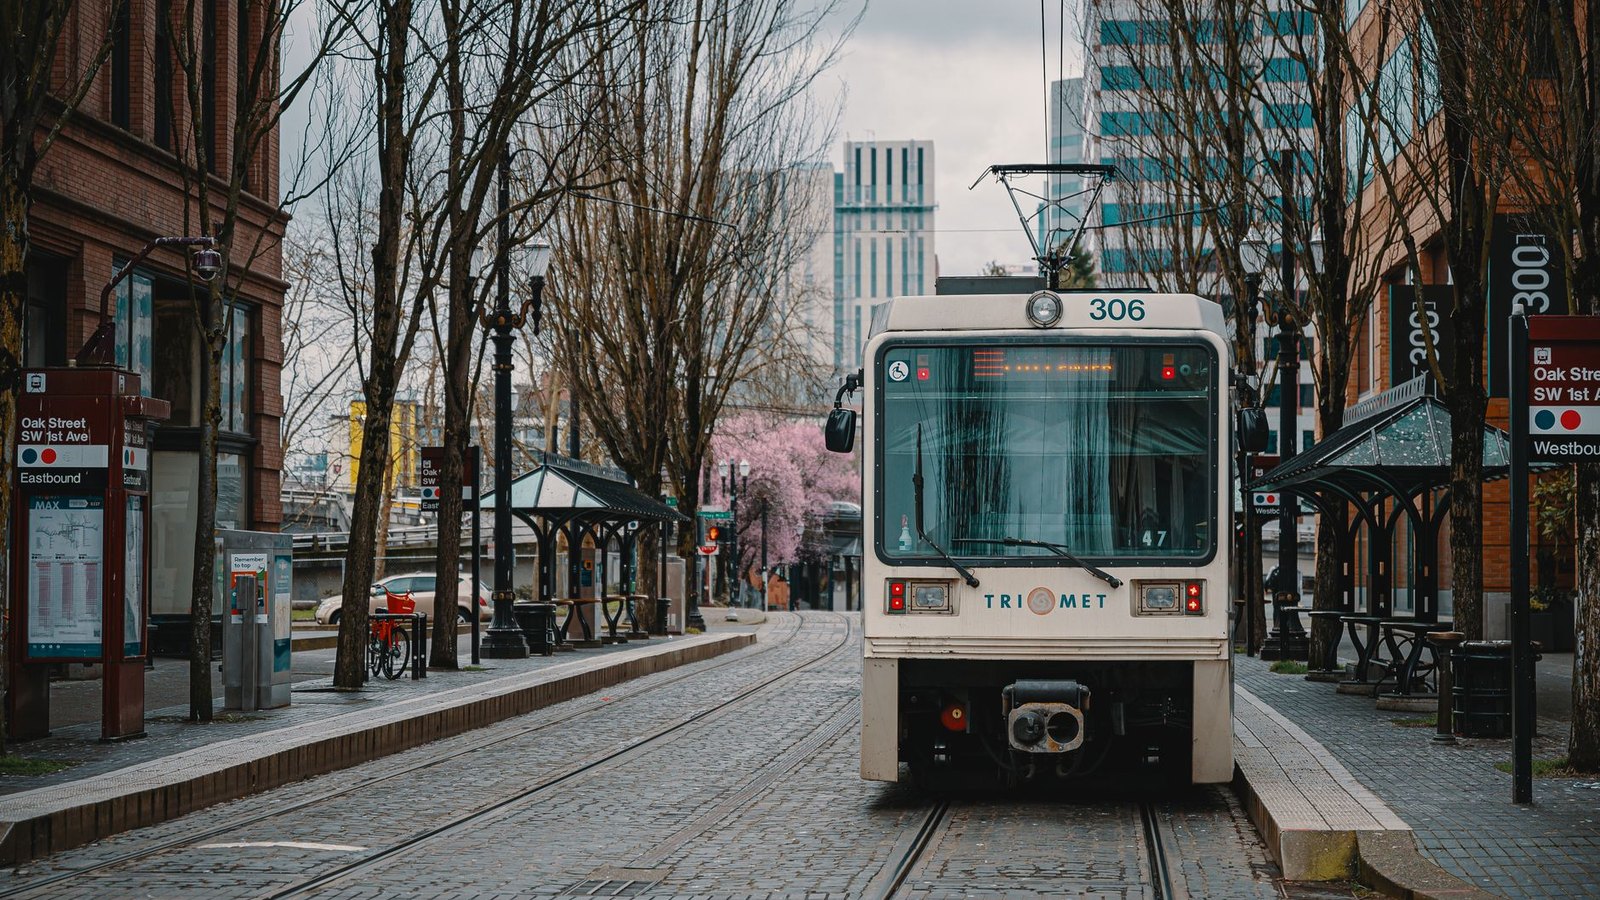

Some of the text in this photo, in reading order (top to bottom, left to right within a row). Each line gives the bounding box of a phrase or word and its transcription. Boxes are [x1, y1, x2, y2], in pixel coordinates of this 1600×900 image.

[1090, 298, 1146, 321] 306
[1533, 367, 1567, 381] Oak
[1533, 387, 1562, 401] SW
[1567, 387, 1590, 401] 1st
[21, 417, 86, 429] Oak Street
[21, 430, 88, 442] SW 1st Ave
[20, 472, 81, 484] Eastbound
[422, 477, 436, 485] SW
[35, 500, 60, 510] MAX
[422, 501, 439, 509] East
[1142, 530, 1167, 547] 47
[984, 594, 1107, 609] TRI MET
